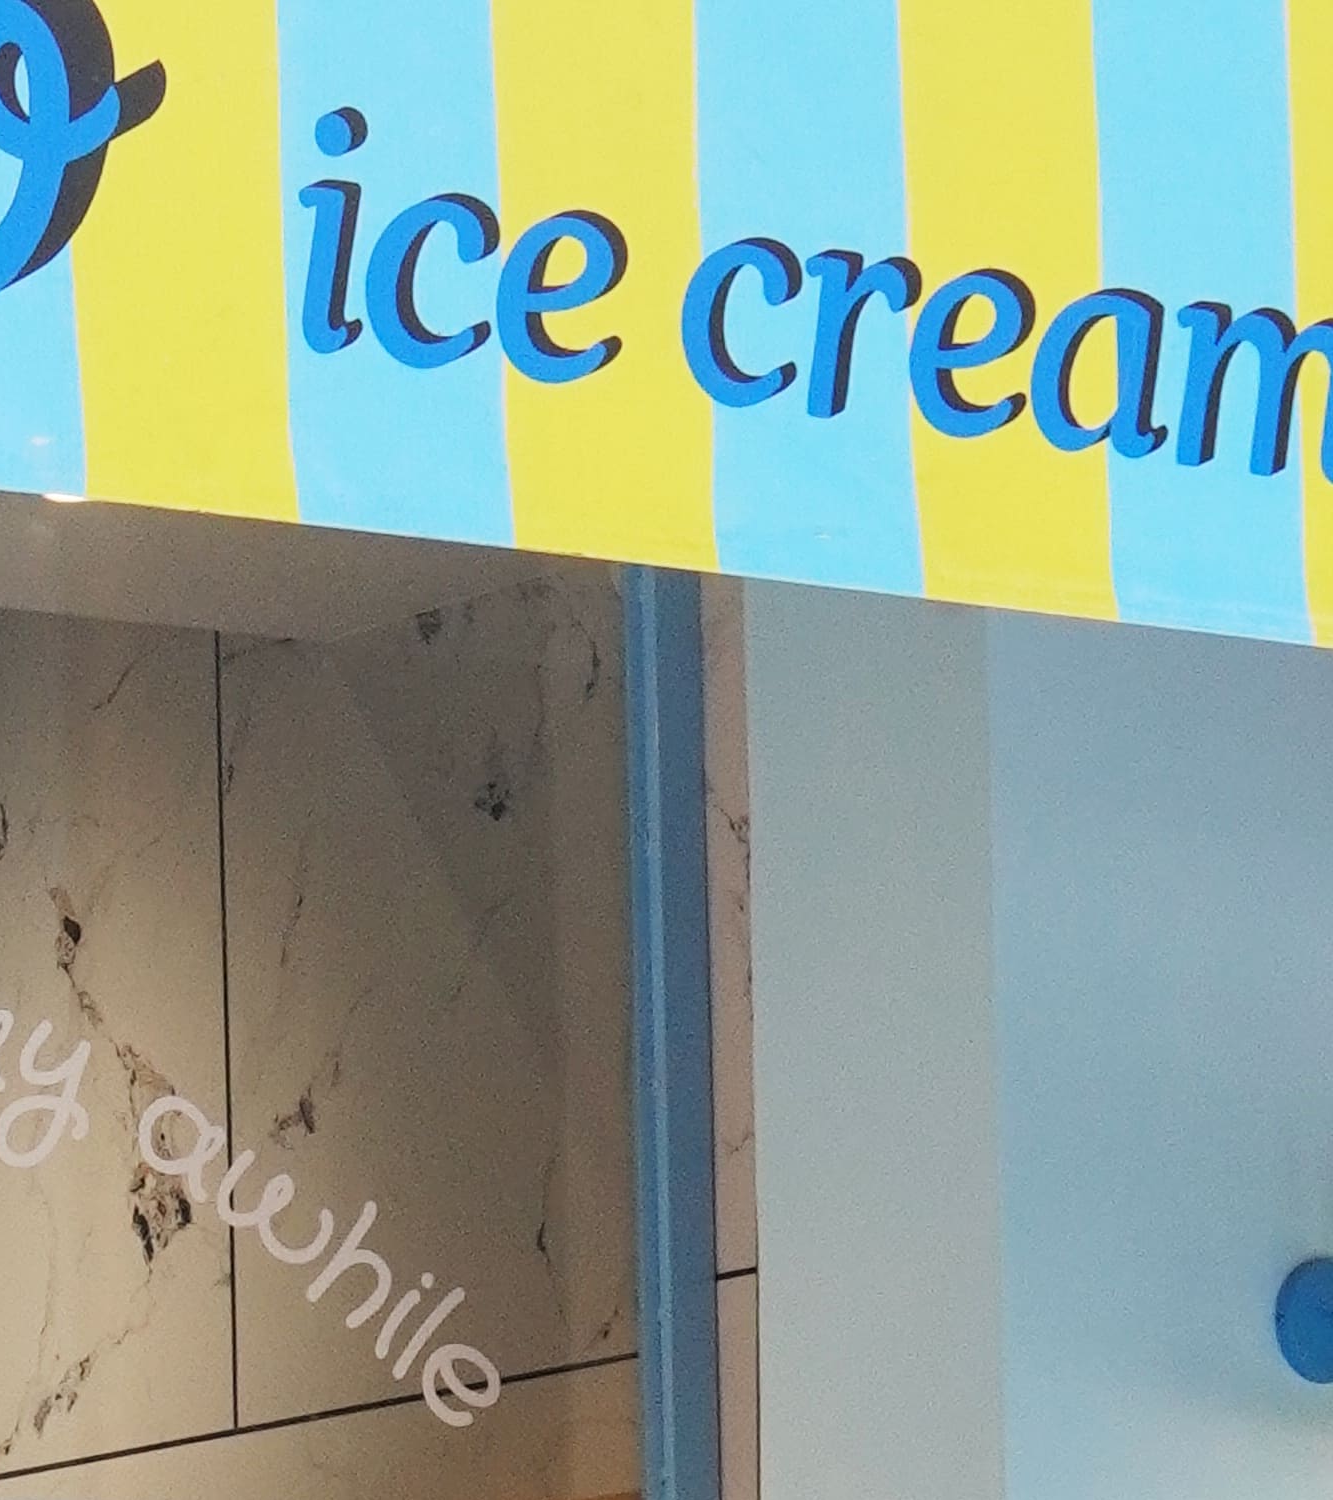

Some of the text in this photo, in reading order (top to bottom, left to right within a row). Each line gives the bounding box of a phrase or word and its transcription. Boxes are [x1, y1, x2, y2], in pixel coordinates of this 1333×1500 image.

[299, 107, 628, 384] ice
[682, 237, 1333, 484] cream
[138, 1095, 501, 1428] awhile
